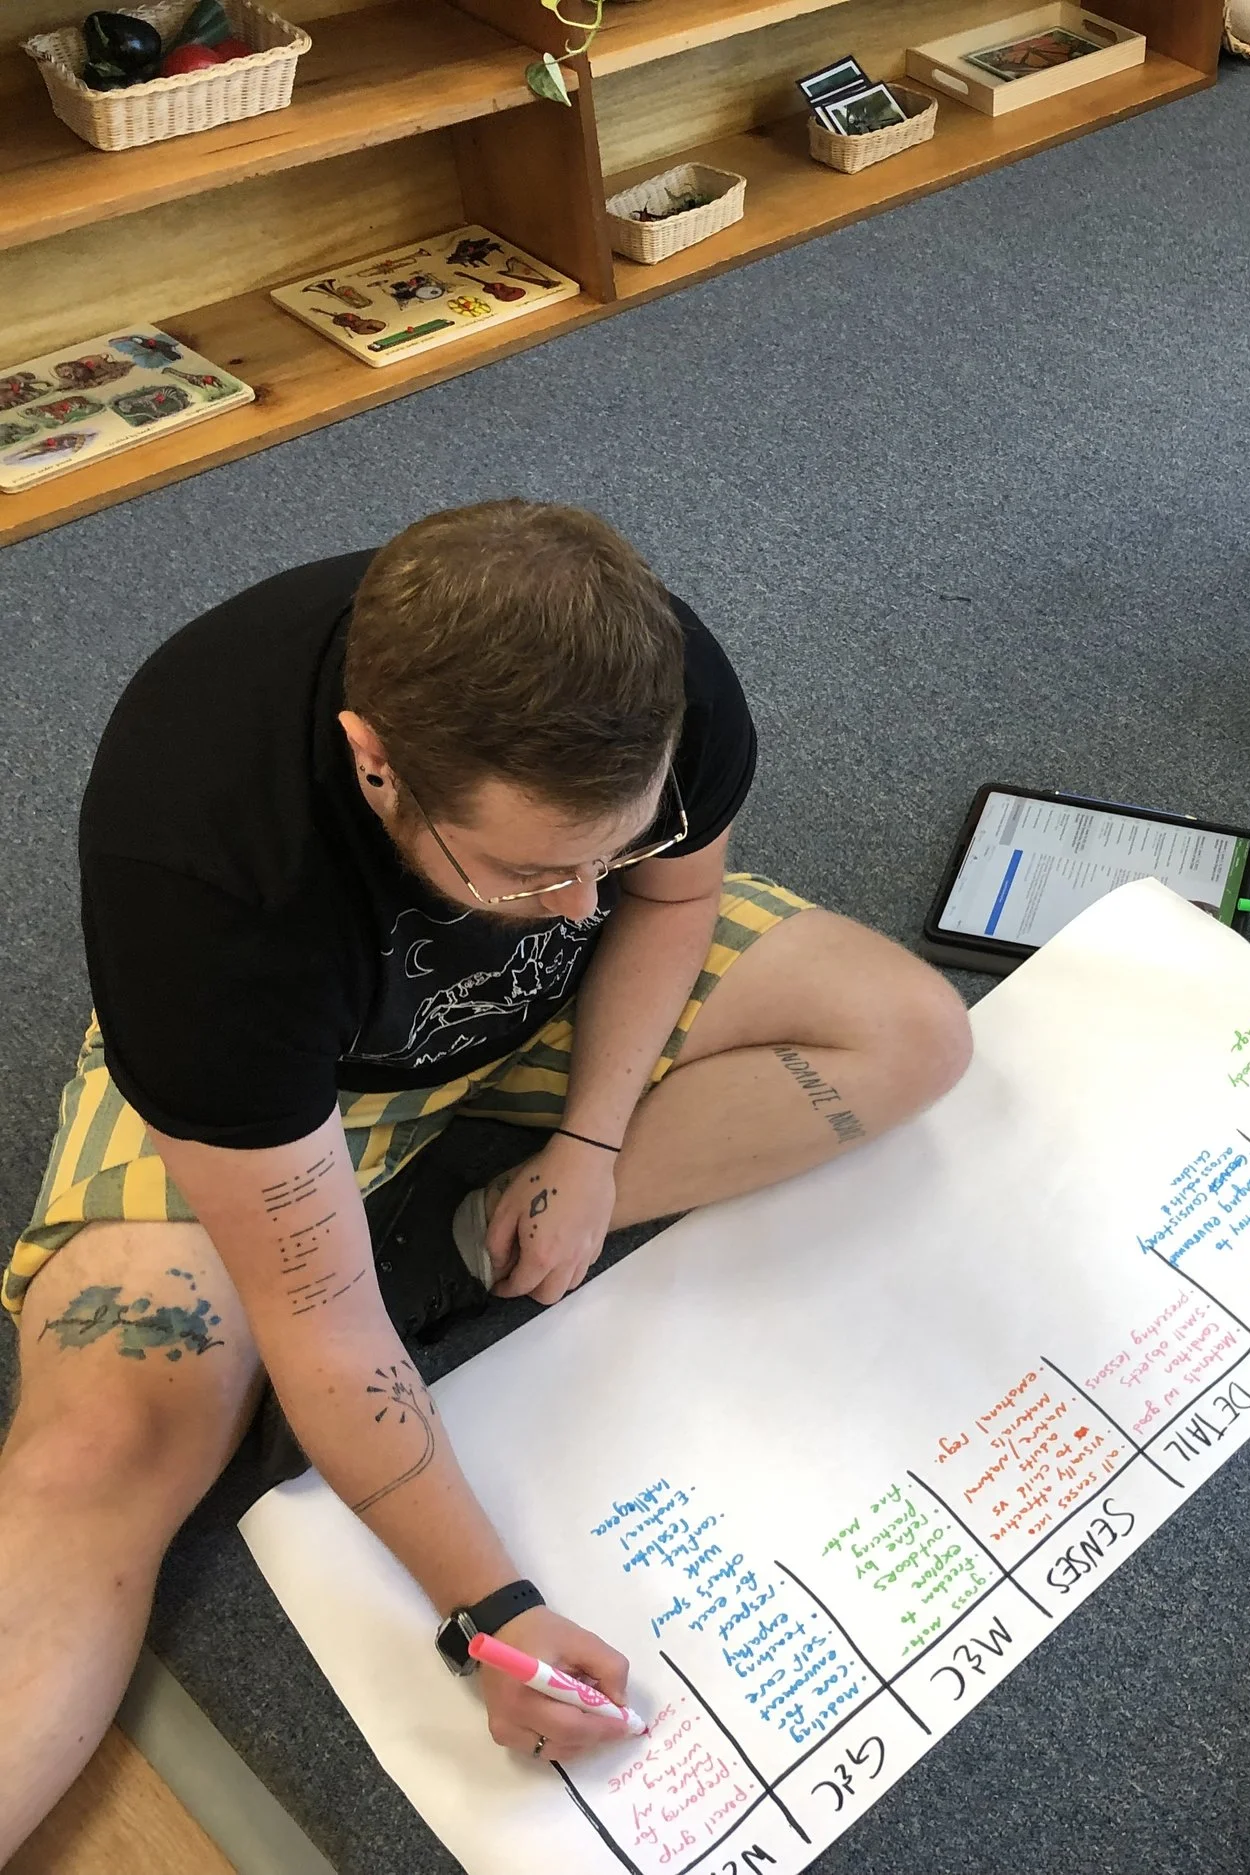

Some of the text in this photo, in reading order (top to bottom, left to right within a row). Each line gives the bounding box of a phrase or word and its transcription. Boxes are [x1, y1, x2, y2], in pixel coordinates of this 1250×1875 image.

[1200, 1146, 1233, 1176] across
[1169, 1177, 1200, 1206] adults
[1214, 1238, 1233, 1250] to
[1084, 1288, 1188, 1390] presenting lessons
[1119, 1340, 1168, 1387] objects
[1132, 1399, 1160, 1435] good
[991, 1442, 1072, 1516] to child vs
[1018, 1432, 1058, 1472] adults
[1101, 1449, 1119, 1473] all
[869, 1482, 901, 1513] fine
[989, 1435, 1104, 1541] visually attractive
[1057, 1471, 1097, 1510] senses
[619, 1489, 689, 1551] Emotional
[622, 1517, 689, 1572] resolution
[850, 1498, 916, 1558] practicing
[855, 1513, 928, 1580] refine by
[1045, 1497, 1135, 1594] SENSES
[695, 1552, 744, 1598] other's
[899, 1556, 975, 1624] freedom to
[910, 1544, 961, 1589] explore
[950, 1572, 986, 1610] gross
[687, 1569, 757, 1631] for each
[718, 1583, 775, 1641] respect
[721, 1612, 788, 1667] empathy
[734, 1619, 806, 1678] teaching
[929, 1614, 1013, 1701] M&C
[744, 1635, 827, 1704] self care
[777, 1664, 848, 1735] care for
[642, 1742, 702, 1789] writing
[666, 1751, 713, 1794] future
[810, 1735, 885, 1812] G&C
[633, 1757, 730, 1845] preparing for
[703, 1783, 747, 1835] pencil
[658, 1829, 696, 1864] grip
